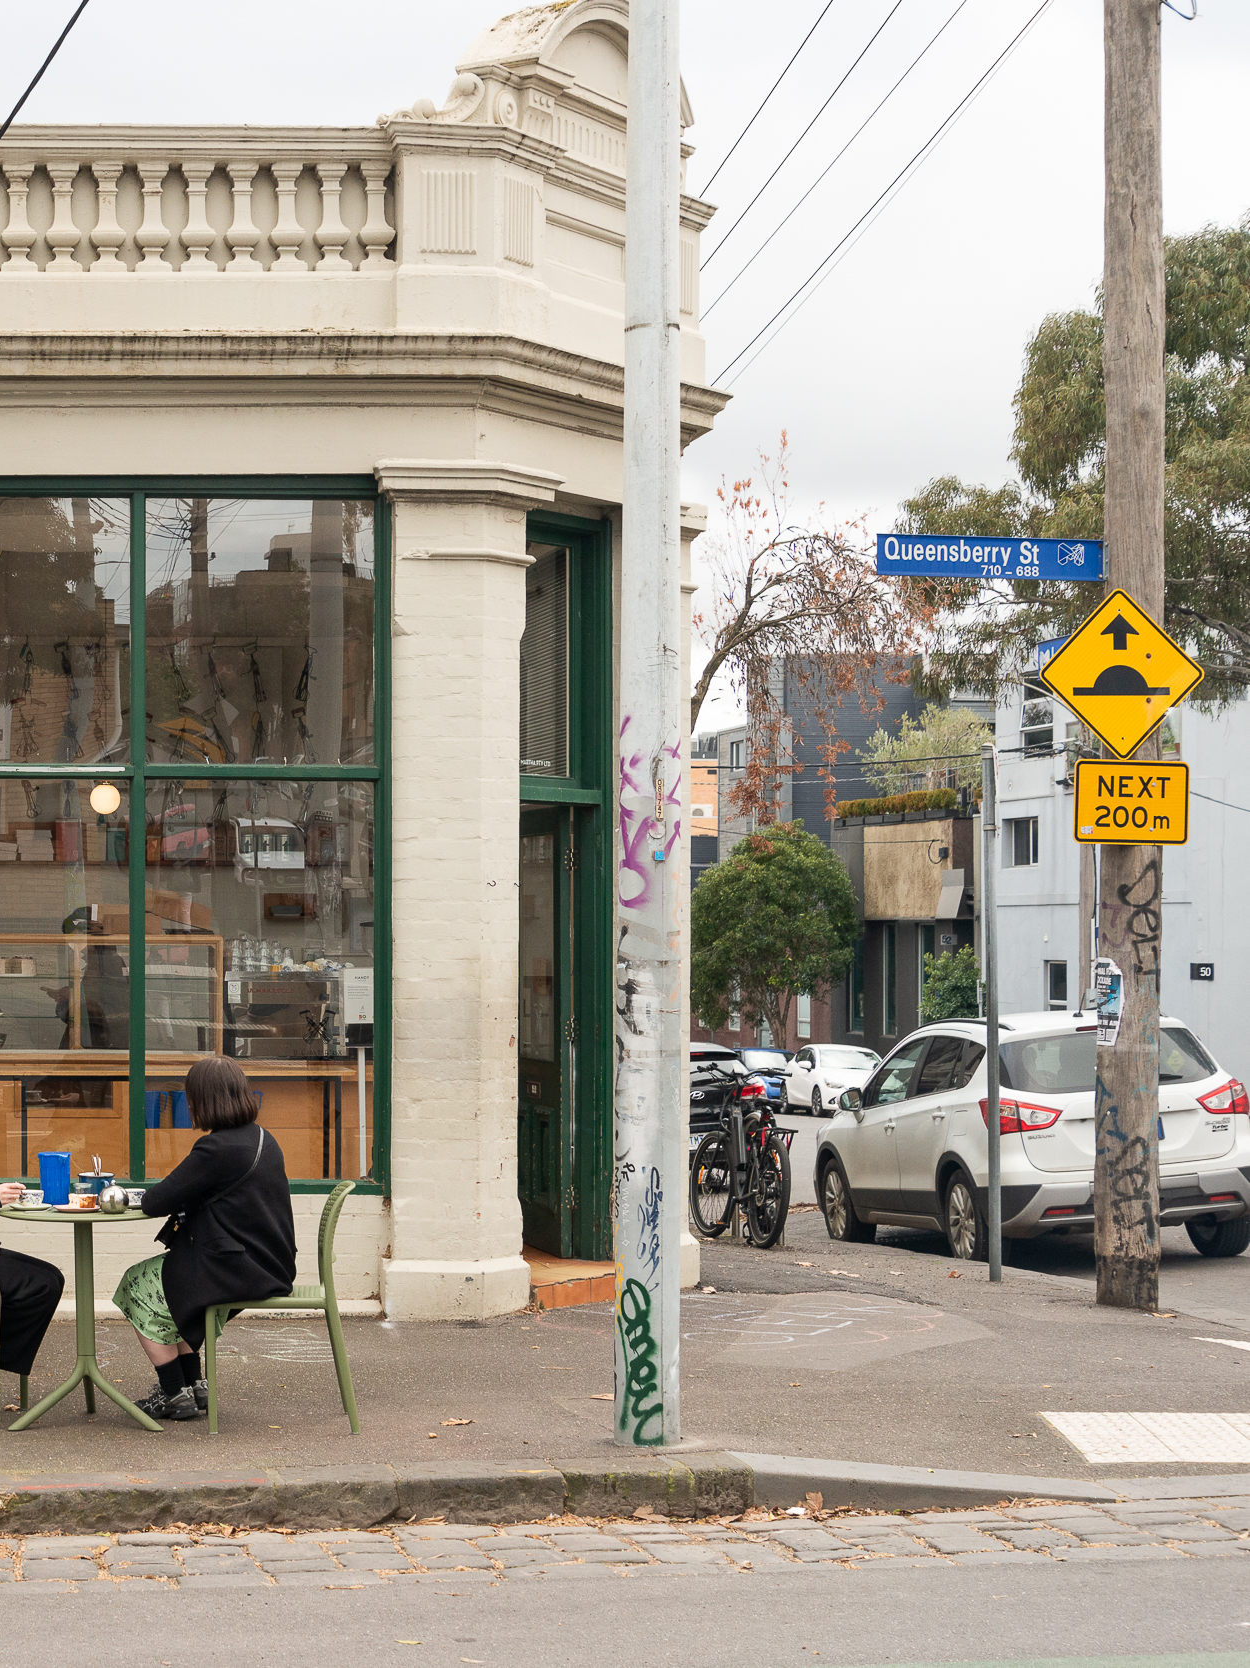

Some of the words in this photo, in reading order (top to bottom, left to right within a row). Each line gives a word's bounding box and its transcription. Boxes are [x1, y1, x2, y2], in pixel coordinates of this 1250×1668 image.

[884, 537, 1012, 567] Queensberry
[1019, 541, 1040, 565] St
[981, 565, 1001, 576] 710
[1016, 566, 1039, 577] 688
[1098, 775, 1171, 799] NEXT
[941, 935, 952, 945] 52
[1200, 967, 1211, 977] 50
